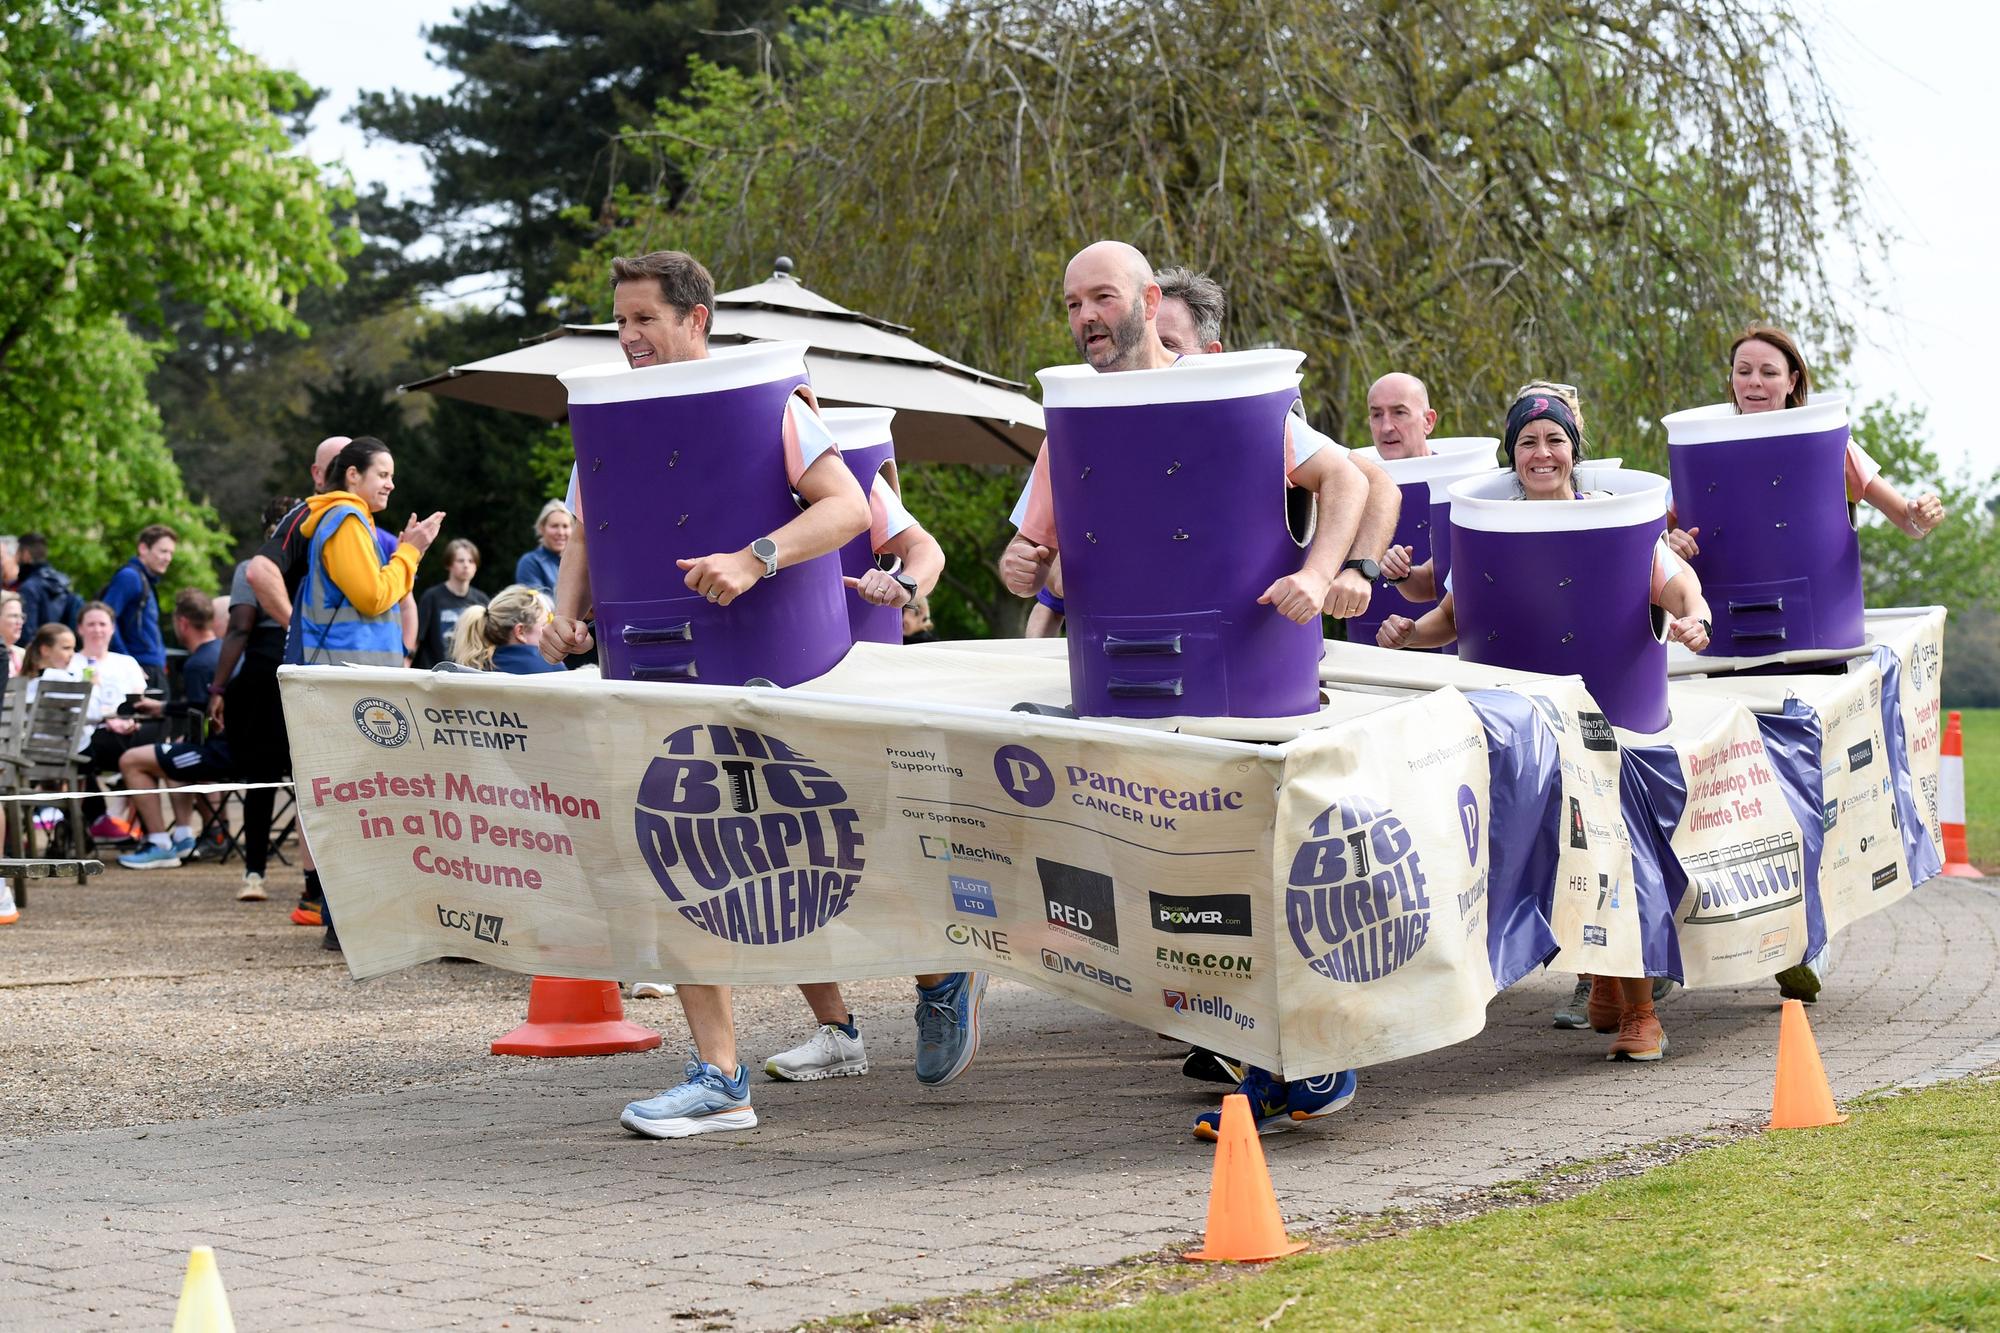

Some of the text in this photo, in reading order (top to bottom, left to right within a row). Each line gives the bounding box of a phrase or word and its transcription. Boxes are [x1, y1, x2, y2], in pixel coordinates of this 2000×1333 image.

[357, 700, 397, 713] GUINNESS
[424, 707, 528, 729] OFFICIAL
[357, 718, 407, 745] WORLD RECORDS
[433, 729, 527, 752] ATTEMPT
[663, 724, 816, 763] THE
[886, 747, 936, 760] Proudly
[891, 760, 963, 777] Supporting
[637, 756, 848, 814] BIG
[1005, 758, 1041, 793] P
[1065, 765, 1244, 812] Pancreatic
[312, 772, 600, 820] Fastest Marathon
[902, 809, 986, 828] Our Sponsors
[1072, 793, 1177, 831] CANCER UK
[1308, 794, 1392, 837] THE
[1690, 797, 1763, 832] Ultimate Test
[359, 809, 573, 856] in a 10 Person
[634, 807, 866, 902] PURPLE
[951, 842, 1012, 865] Machins
[1288, 816, 1412, 887] BIG
[413, 846, 542, 890] Costume
[952, 880, 989, 895] T.LOTT
[1569, 876, 1587, 892] HBE
[437, 904, 471, 931] tcs
[678, 869, 862, 945] CHALLENGE
[964, 899, 985, 910] LTD
[1049, 900, 1093, 930] RED
[1160, 904, 1190, 912] Specialist
[1160, 910, 1223, 924] POWER
[1285, 851, 1431, 959] PURPLE
[945, 923, 1011, 954] ONE
[1048, 923, 1119, 955] Construction Group Ltd
[1308, 912, 1431, 983] CHALLENGE
[1063, 956, 1132, 993] MGBC
[1156, 946, 1252, 972] ENGCON
[1156, 961, 1252, 980] CONSTRUCTION
[1190, 994, 1255, 1030] riello ups
